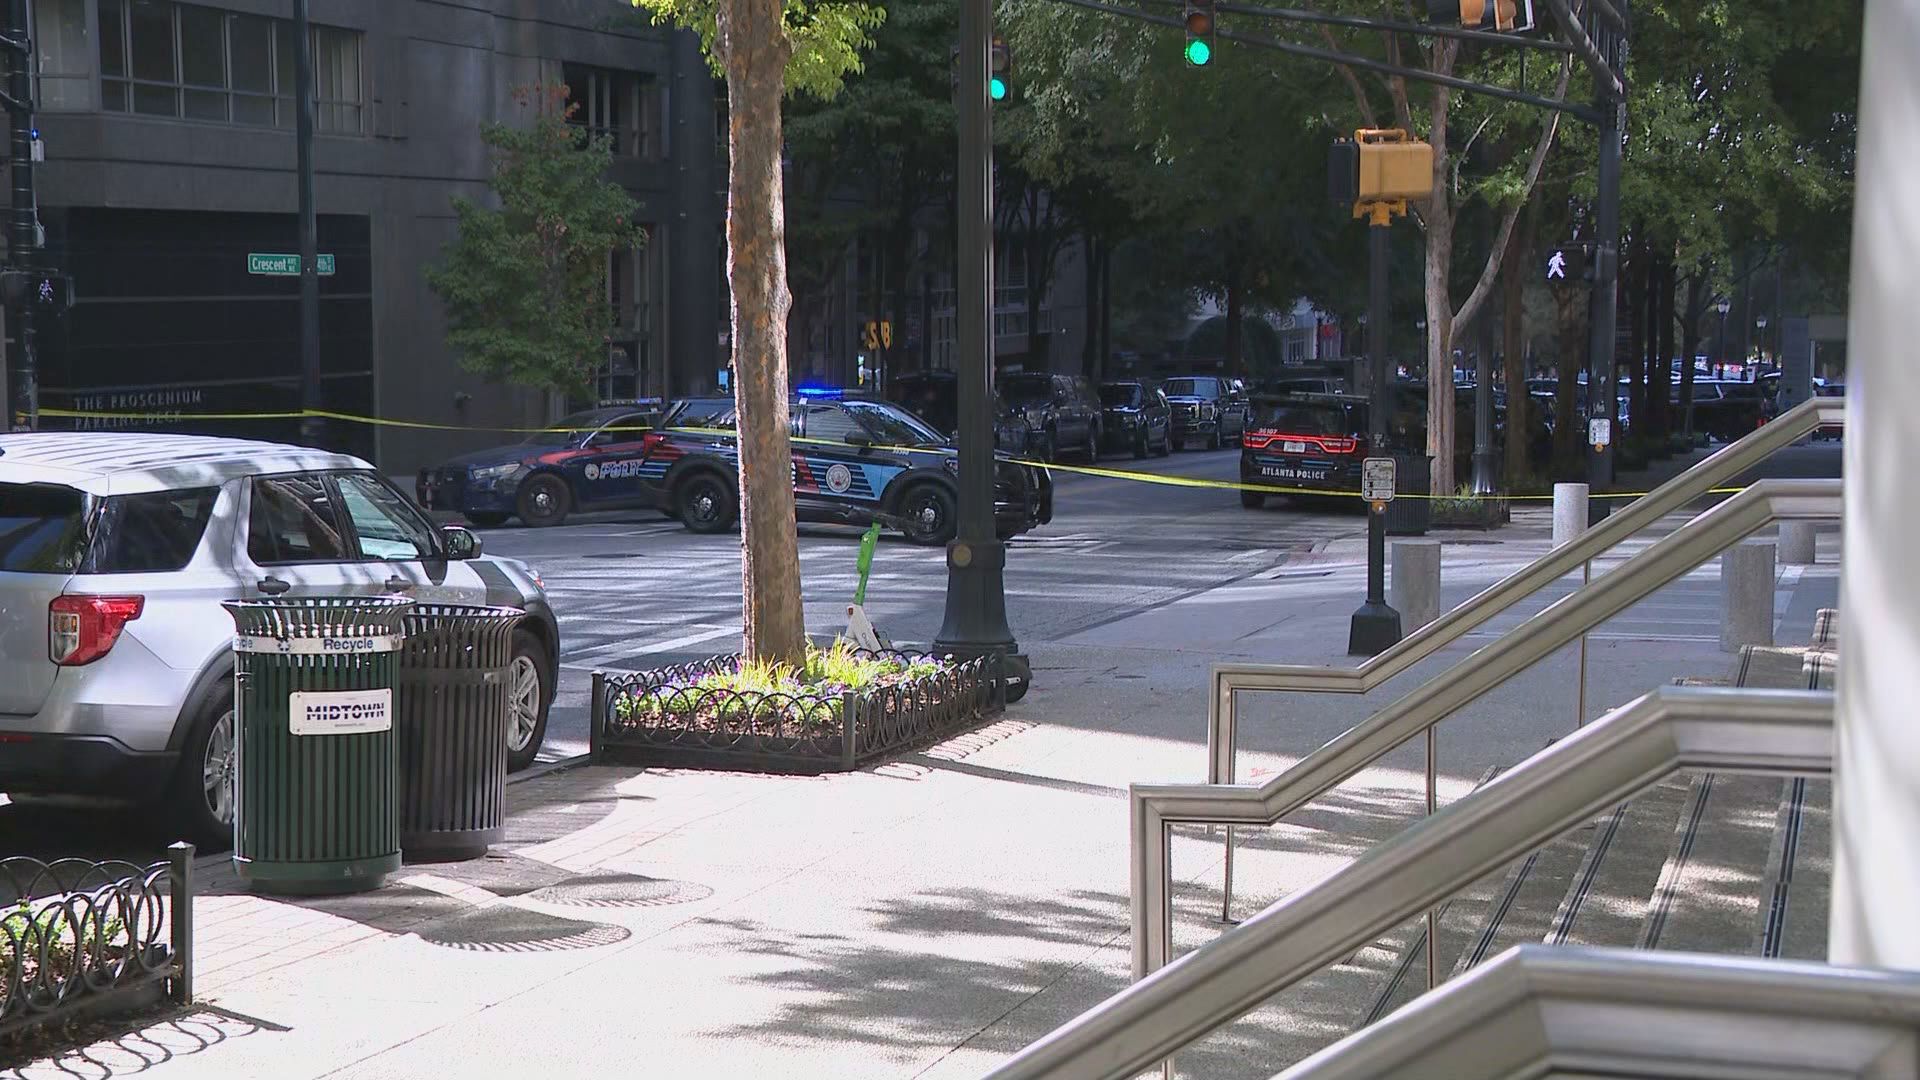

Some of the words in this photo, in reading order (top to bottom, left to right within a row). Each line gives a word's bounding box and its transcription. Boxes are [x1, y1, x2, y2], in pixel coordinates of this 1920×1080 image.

[252, 257, 287, 271] Crescent
[74, 397, 104, 411] THE
[111, 389, 202, 409] PROSCENIUM
[1261, 467, 1295, 478] ATLANTA
[1296, 468, 1325, 479] POLICE
[323, 638, 374, 652] Recycle
[306, 703, 385, 721] MIDTOWN
